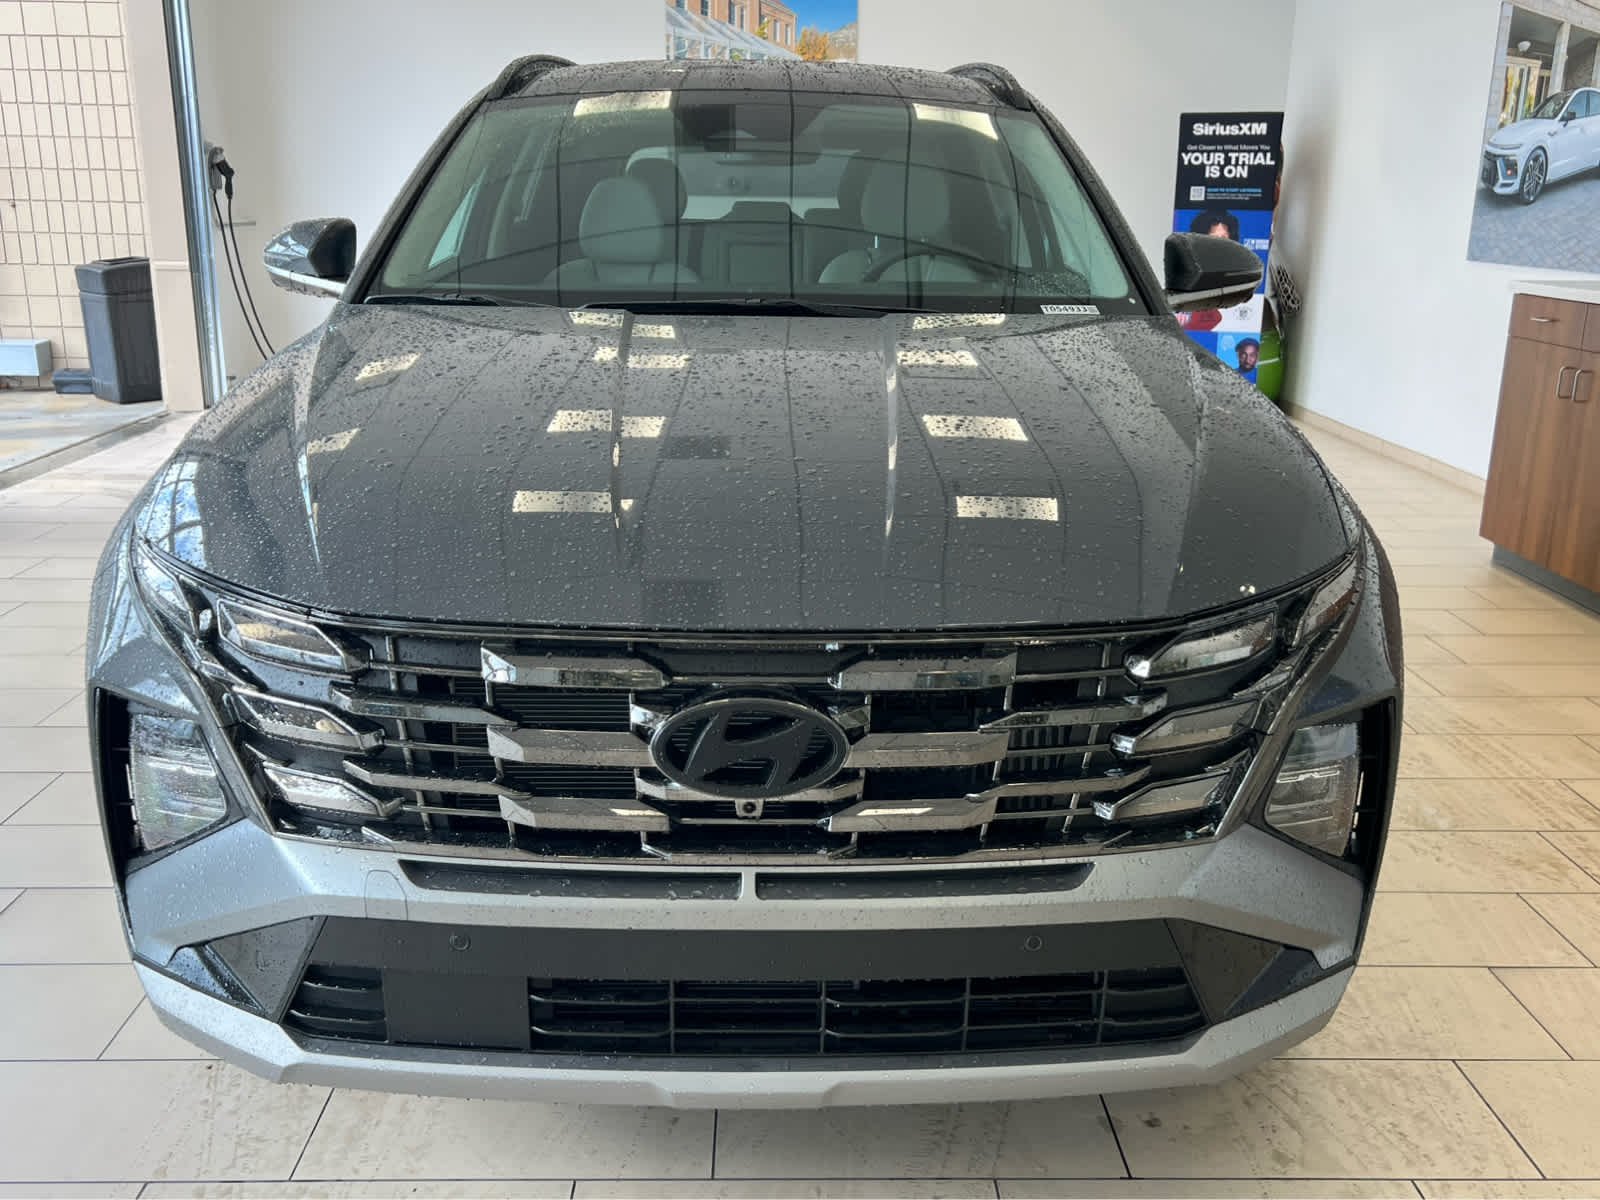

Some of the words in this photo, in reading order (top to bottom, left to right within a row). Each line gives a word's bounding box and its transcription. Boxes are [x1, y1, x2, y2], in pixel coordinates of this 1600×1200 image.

[1192, 122, 1267, 136] SiriusXM
[1181, 152, 1225, 165] YOUR
[1228, 152, 1275, 165] TRIAL
[1205, 165, 1220, 178] IS
[1223, 165, 1248, 178] ON
[1043, 305, 1089, 313] T054933
